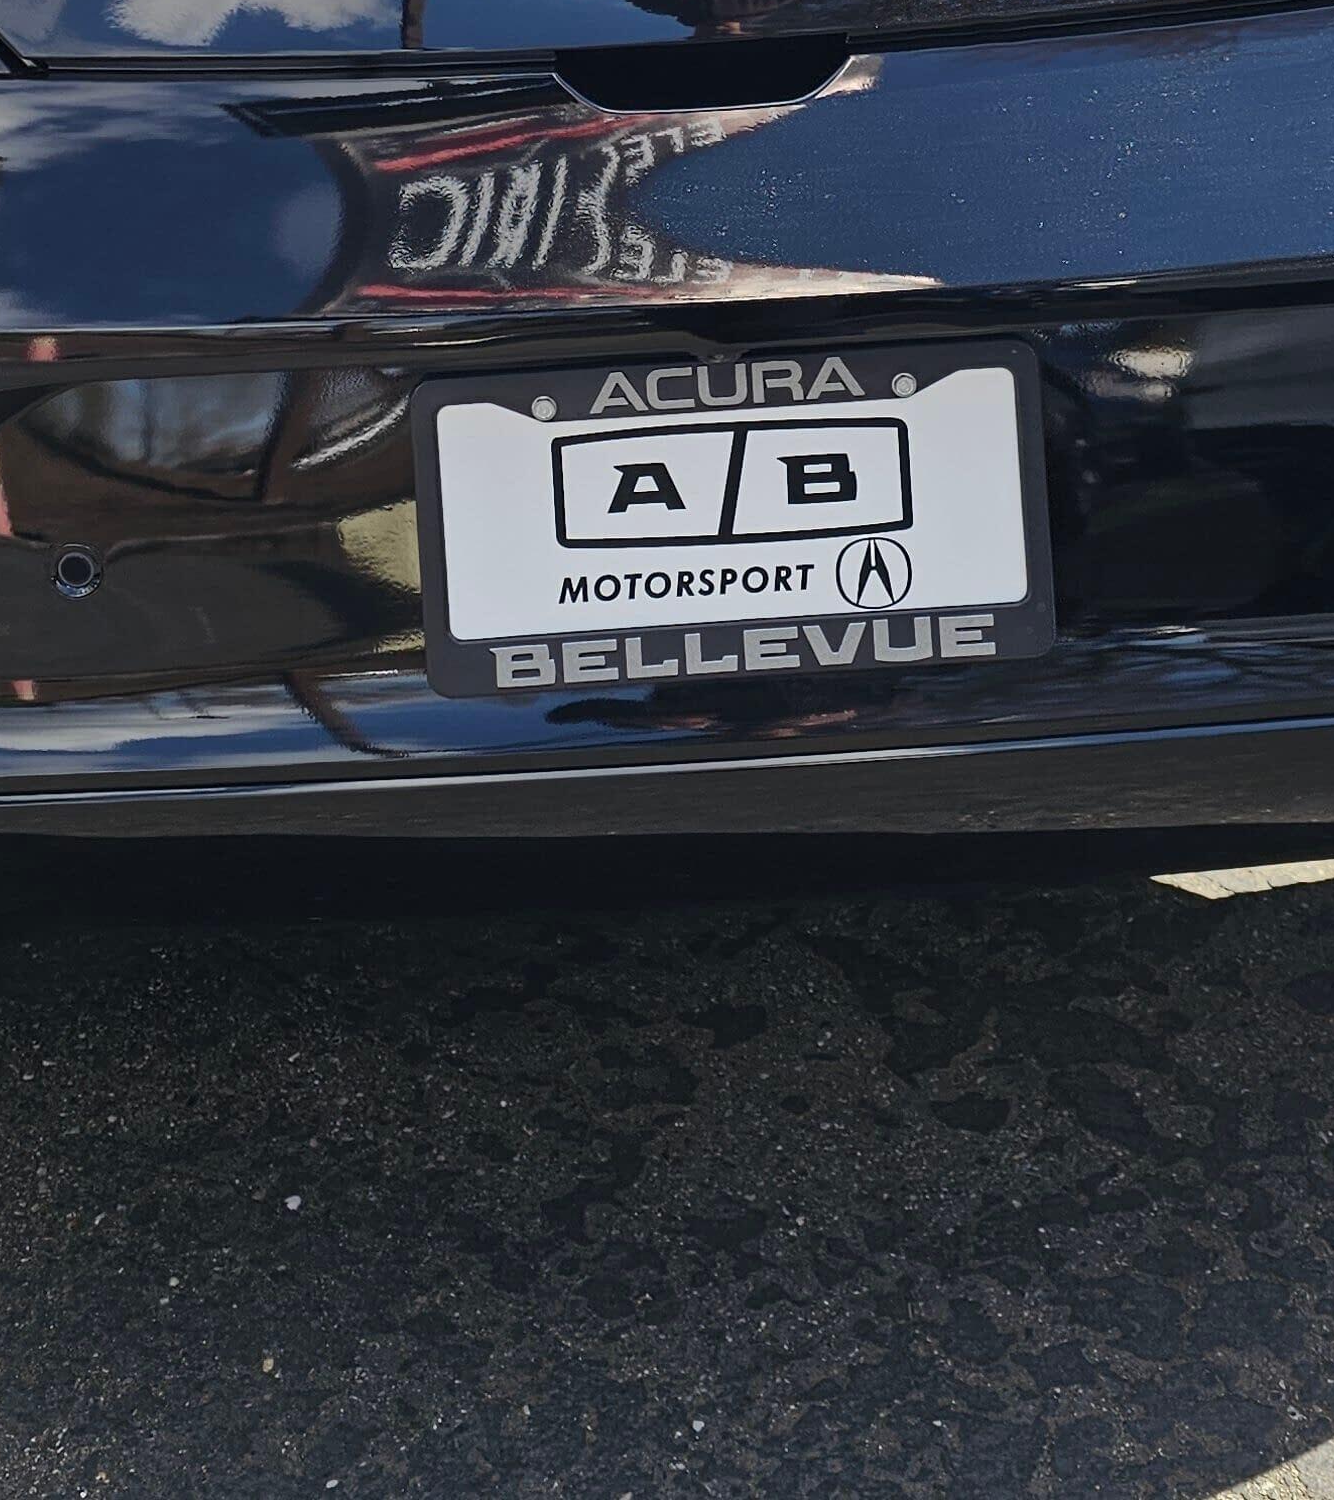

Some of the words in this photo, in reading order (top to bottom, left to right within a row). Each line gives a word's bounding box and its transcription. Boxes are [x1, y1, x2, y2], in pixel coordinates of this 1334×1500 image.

[589, 356, 865, 415] ACURA
[608, 462, 686, 513] A
[776, 453, 857, 505] B
[559, 564, 815, 604] MOTORSPORT
[489, 614, 997, 688] BELLEVUE
